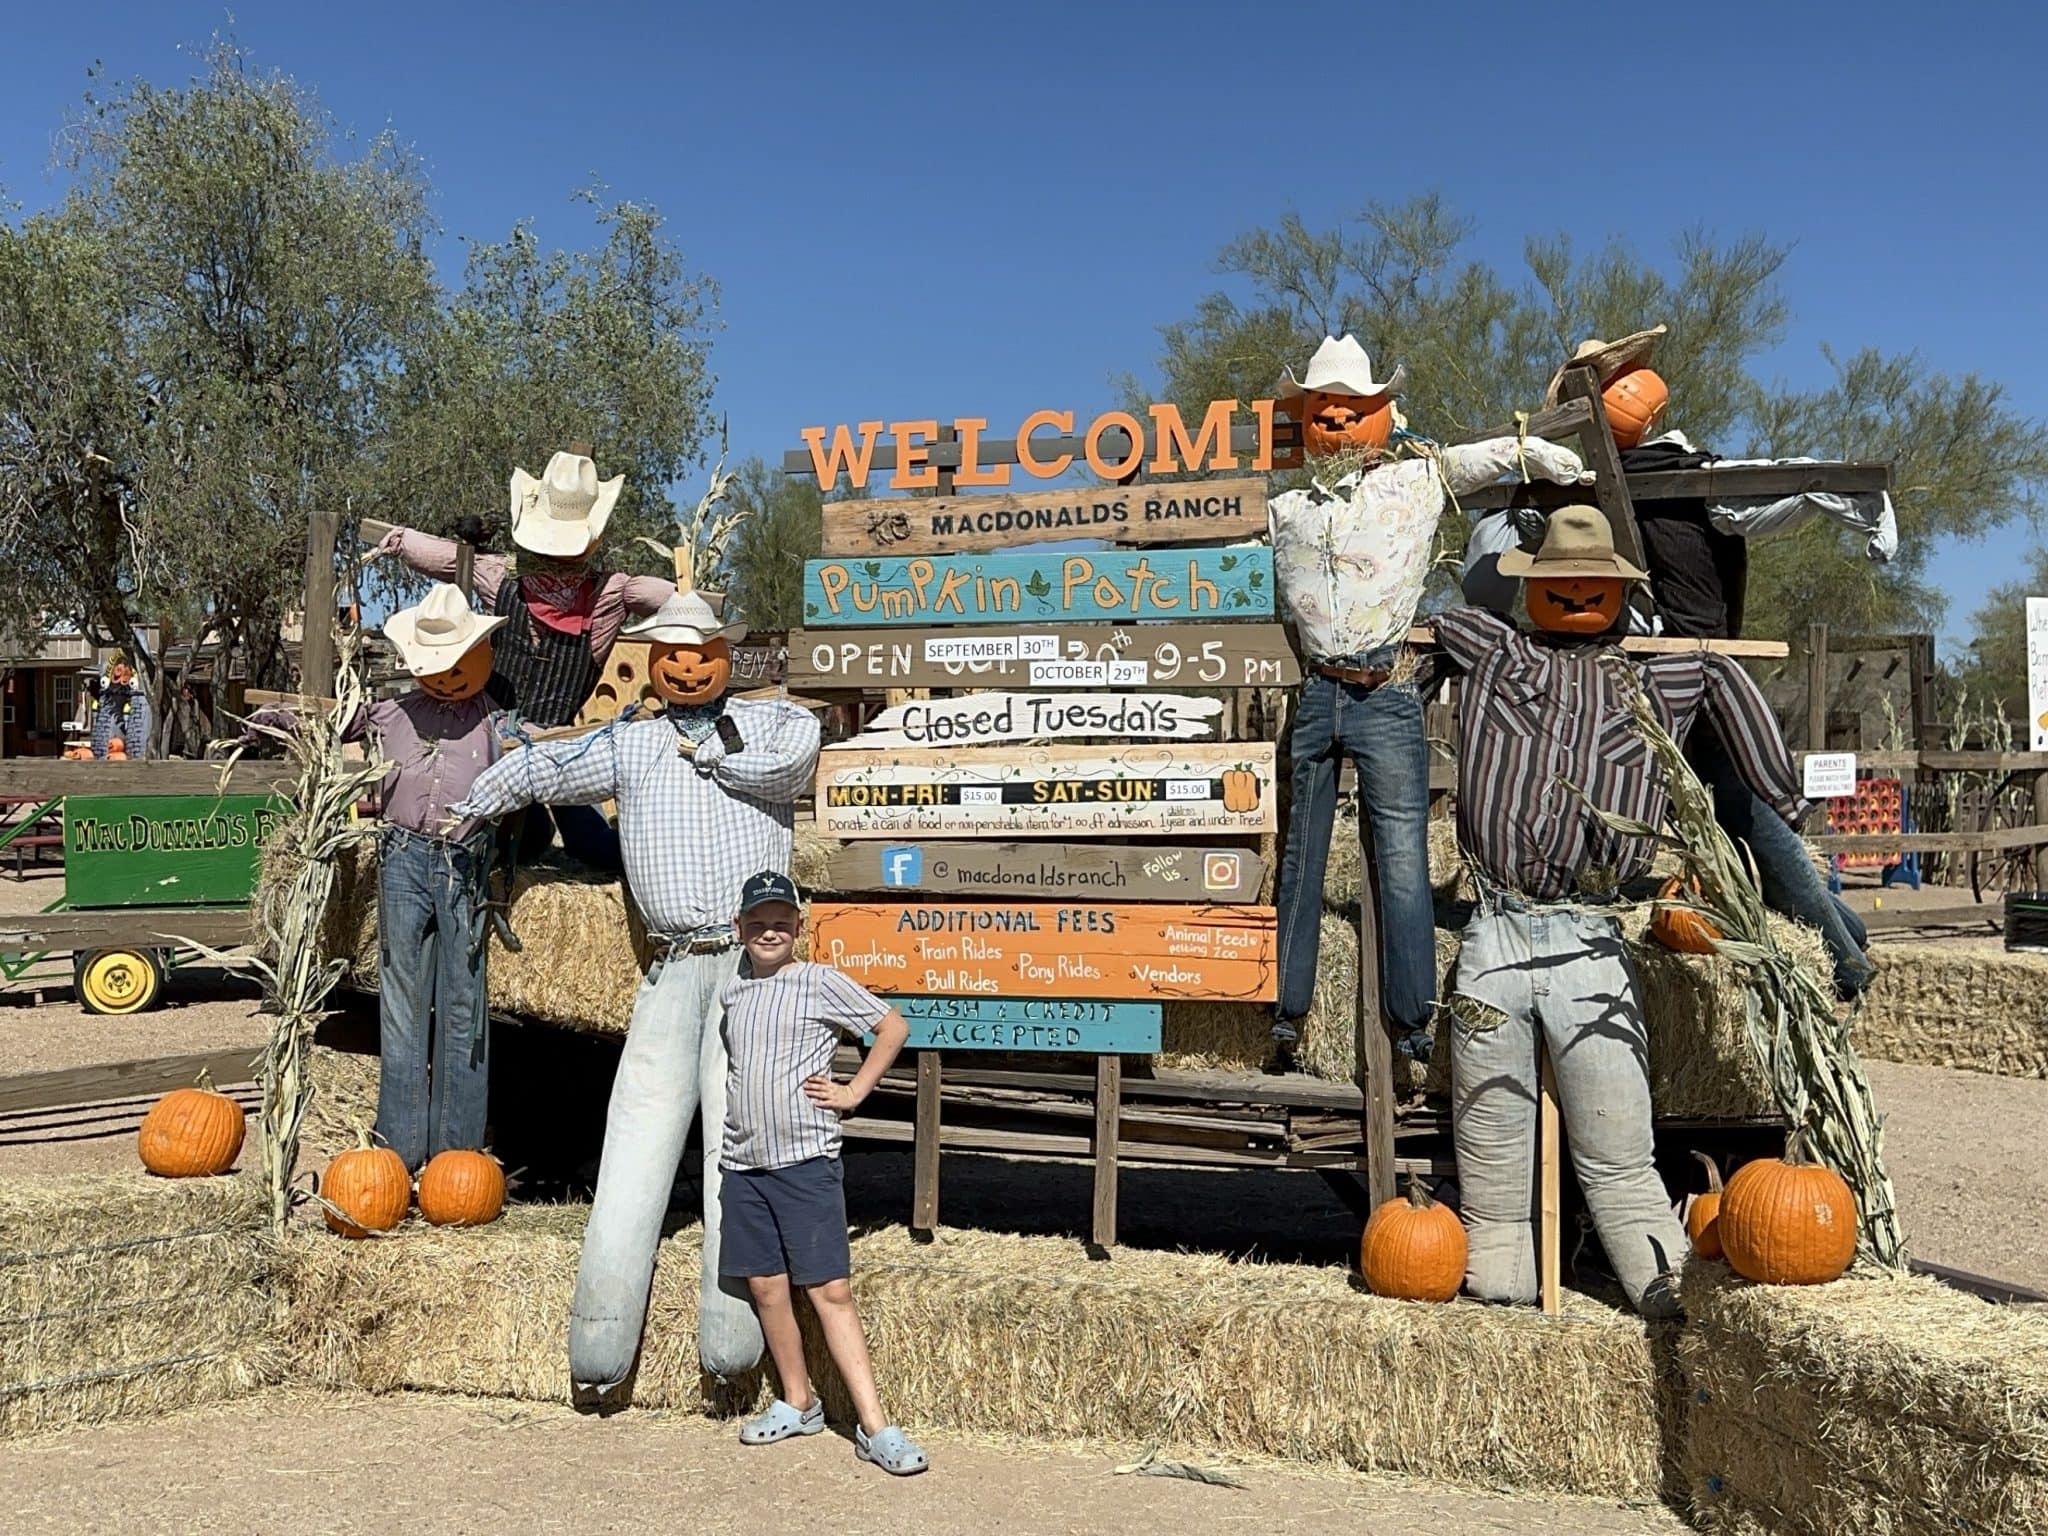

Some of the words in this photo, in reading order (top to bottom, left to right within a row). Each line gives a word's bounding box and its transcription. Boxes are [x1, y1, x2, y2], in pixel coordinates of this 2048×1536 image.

[801, 399, 1304, 491] WELCOME
[932, 502, 1129, 535] MACDONALDS
[1145, 496, 1241, 520] RANCH
[1062, 556, 1220, 612] Patch
[729, 649, 769, 679] PEN
[811, 643, 913, 676] OPEN
[928, 643, 1013, 658] SEPTEMBER
[1023, 639, 1054, 654] 30TH
[1244, 658, 1282, 683] PM
[1033, 666, 1103, 680] OCTOBER
[1114, 666, 1145, 680] 29TH
[902, 697, 1013, 742] Closed
[1813, 759, 1847, 769] PARENTS
[827, 783, 949, 806] MON-FRI:
[963, 790, 997, 802] $15.00
[1032, 779, 1158, 802] SAT-SUN:
[1169, 784, 1205, 796] $15.00
[828, 815, 868, 832] Donate
[903, 814, 915, 830] of
[918, 813, 942, 830] food
[944, 819, 956, 830] or
[1088, 812, 1106, 830] off
[1189, 808, 1206, 827] and
[957, 862, 1127, 887] macdonaldsranch
[1142, 851, 1183, 878] Follow
[897, 909, 1041, 933] ADDITIONAL
[1057, 909, 1116, 934] FEES
[917, 936, 958, 961] Train
[961, 936, 1003, 961] Rides
[1164, 925, 1211, 945] Animal
[1215, 928, 1249, 947] Feed
[831, 938, 908, 975] Pumpkins
[1213, 946, 1239, 959] Zoo
[925, 969, 956, 992] Bull
[959, 970, 999, 993] Rides
[1018, 952, 1055, 985] Pony
[1058, 955, 1101, 980] Rides
[1133, 964, 1202, 984] Vendors
[908, 999, 980, 1018] CASH
[1024, 1000, 1116, 1022] CREDIT
[929, 1020, 1081, 1047] ACCEPTED
